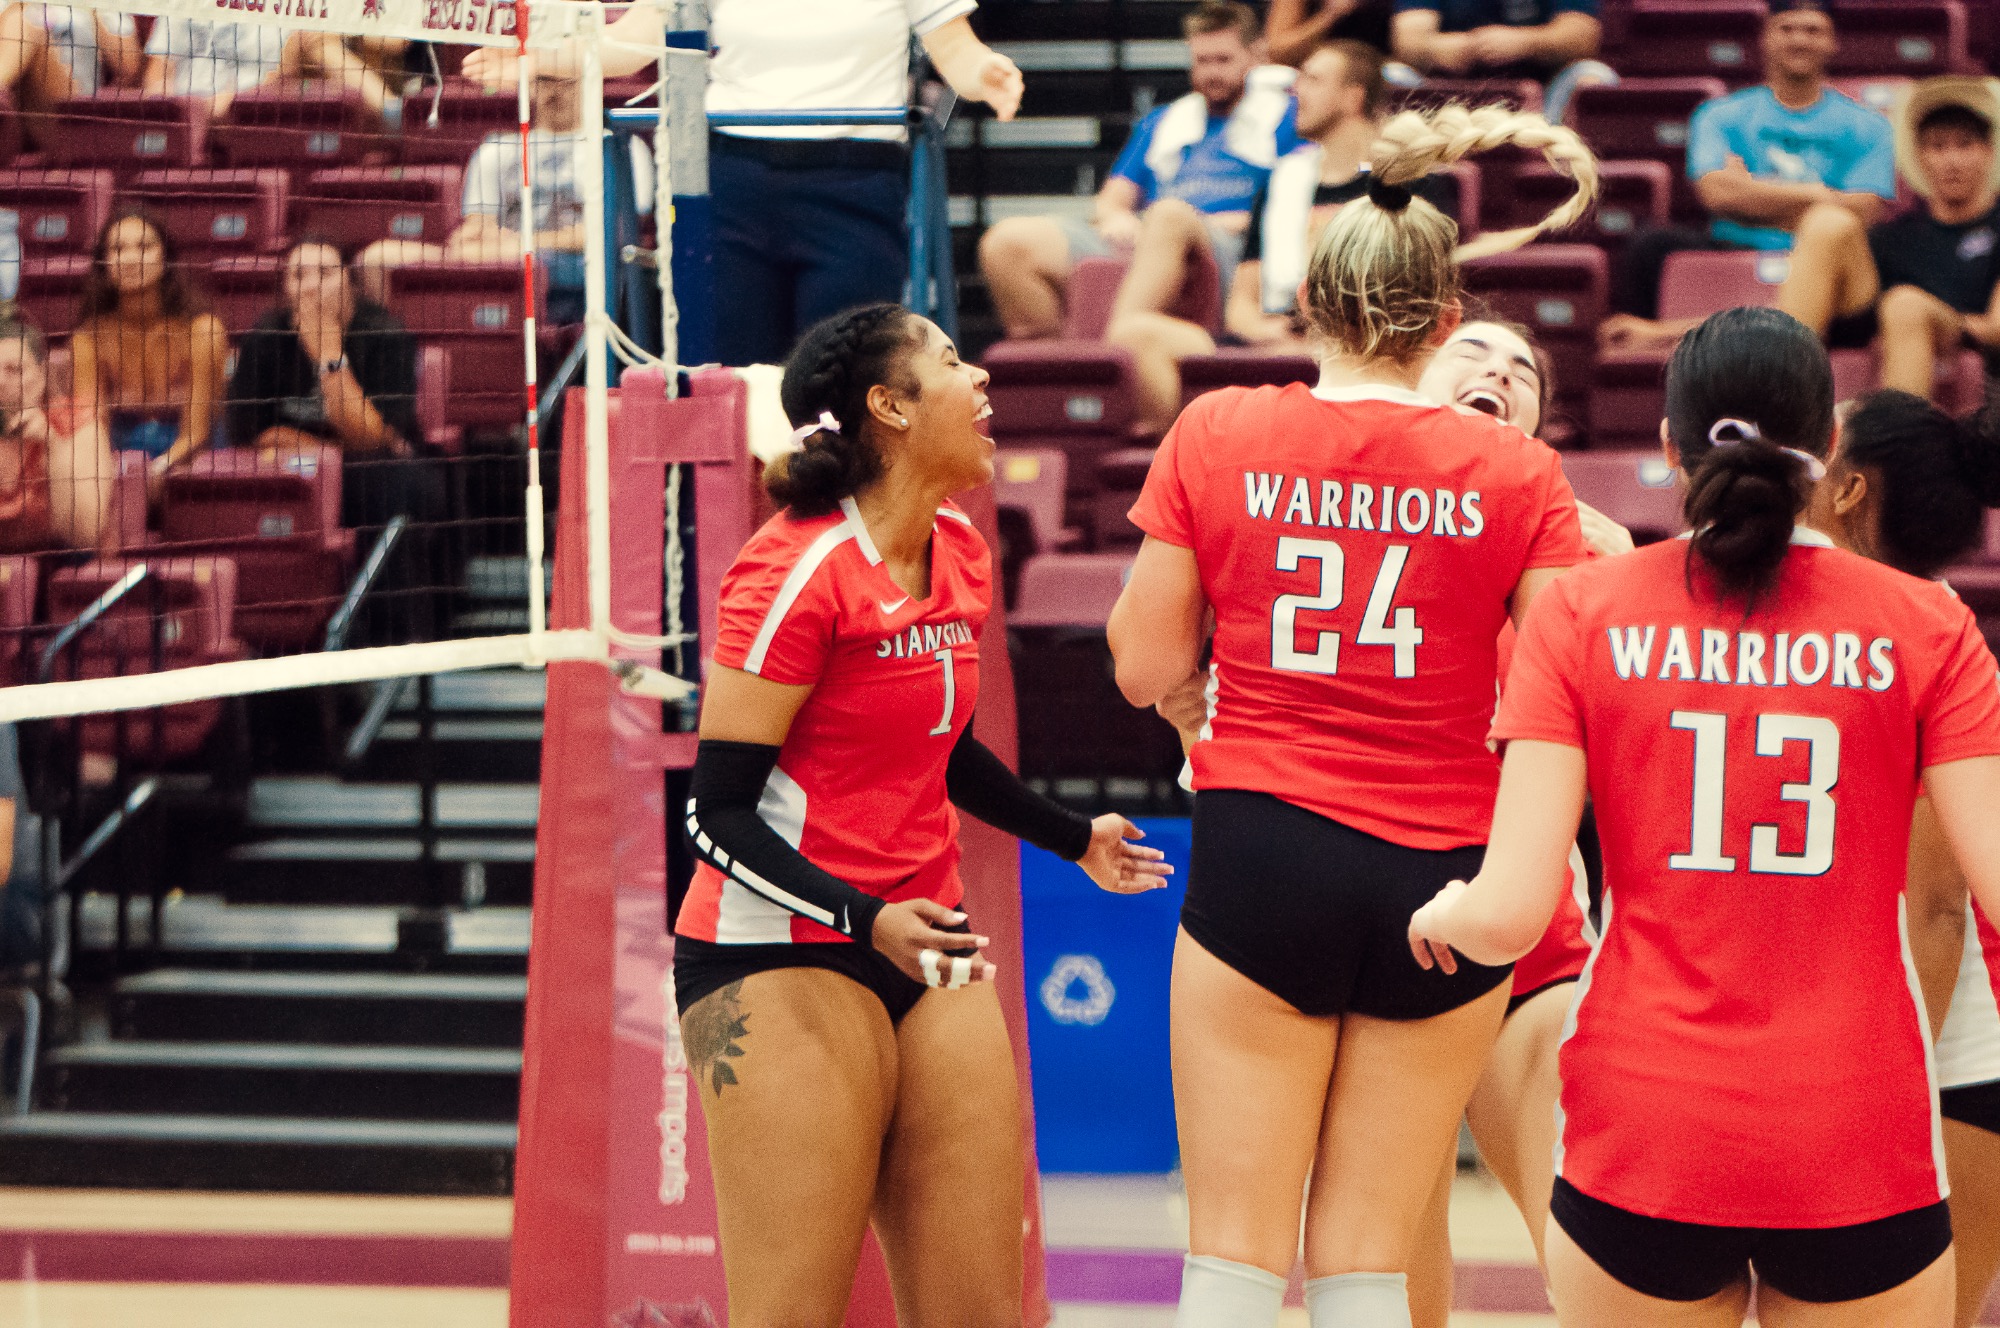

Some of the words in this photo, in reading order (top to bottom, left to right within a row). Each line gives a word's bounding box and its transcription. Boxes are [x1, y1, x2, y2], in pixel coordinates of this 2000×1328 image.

[1245, 472, 1484, 537] WARRIORS
[1271, 536, 1423, 678] 24
[929, 648, 955, 736] 1
[1607, 626, 1894, 691] WARRIORS
[1669, 710, 1839, 876] 13
